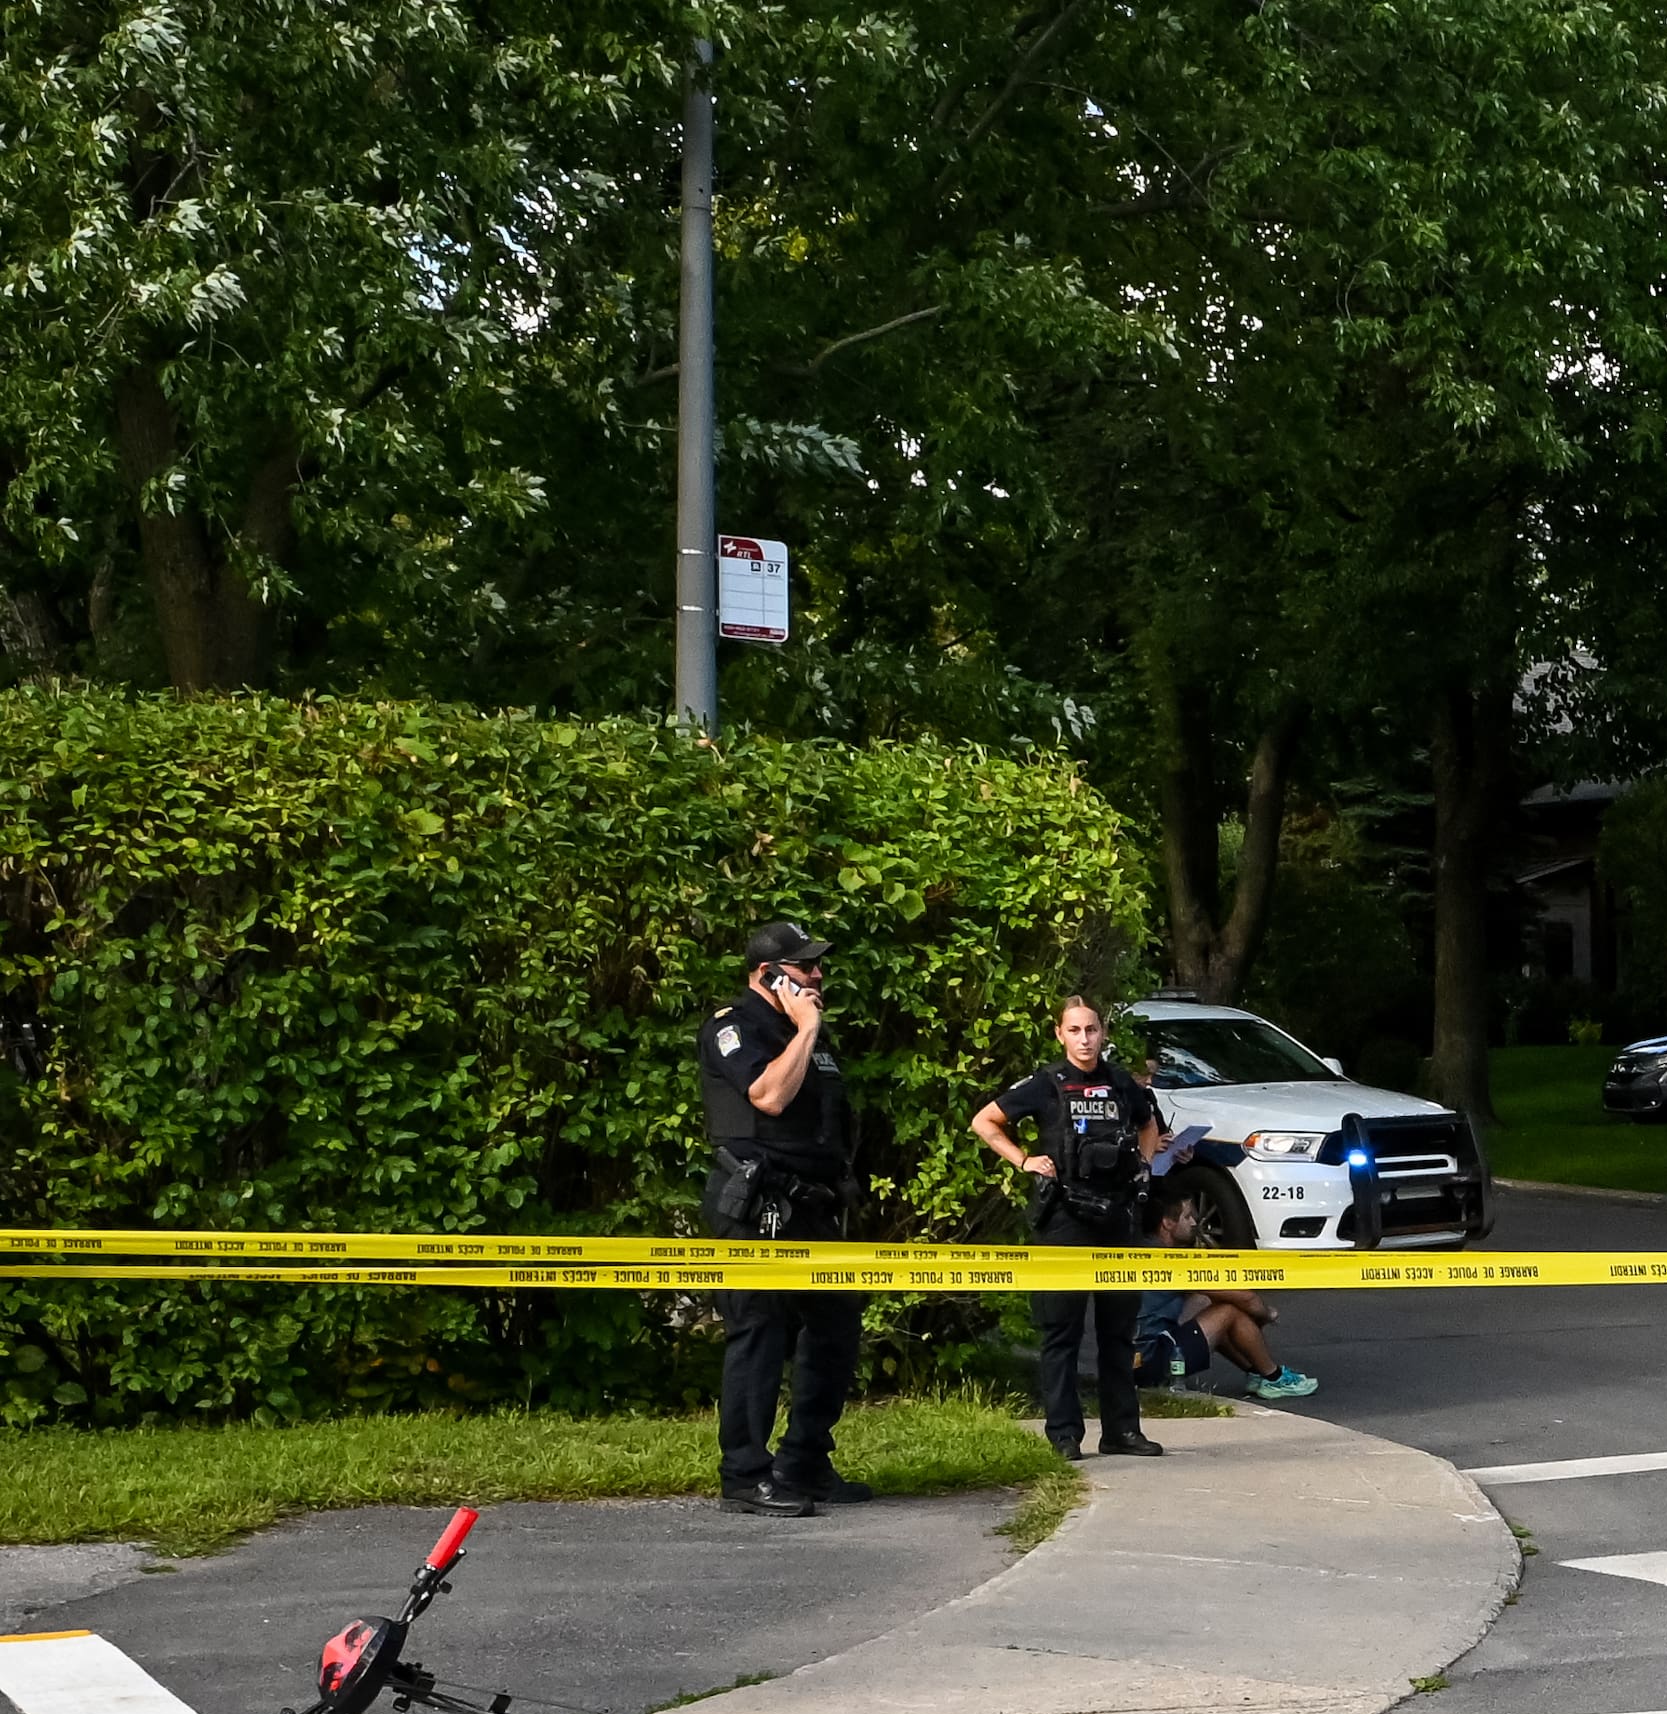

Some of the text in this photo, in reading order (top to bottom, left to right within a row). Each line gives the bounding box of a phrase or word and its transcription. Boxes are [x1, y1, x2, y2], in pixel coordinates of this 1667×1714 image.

[767, 563, 781, 574] 37
[1070, 1100, 1105, 1114] POLICE
[1262, 1186, 1305, 1200] 22-18
[417, 1244, 453, 1254] INTERDIT
[497, 1245, 526, 1255] POLICE
[530, 1245, 541, 1255] DE
[546, 1245, 583, 1256] BARRAGE
[508, 1270, 557, 1282] INTERDIT
[612, 1271, 650, 1282] POLICE
[656, 1271, 670, 1282] DE
[1095, 1270, 1137, 1283] INTERDIT
[1186, 1269, 1219, 1282] POLICE
[1224, 1269, 1237, 1282] DE
[1242, 1268, 1285, 1281] BARRAGE
[1361, 1267, 1401, 1280] INTERDIT
[1447, 1267, 1478, 1279] POLICE
[1483, 1266, 1495, 1278] DE
[1499, 1265, 1539, 1278] BARRAGE
[1610, 1264, 1647, 1277] INTERDIT
[676, 1271, 724, 1283] BARRAGE
[811, 1271, 855, 1284] INTERDIT
[909, 1271, 943, 1284] POLICE
[949, 1271, 962, 1283] DE
[967, 1271, 1013, 1284] BARRAGE
